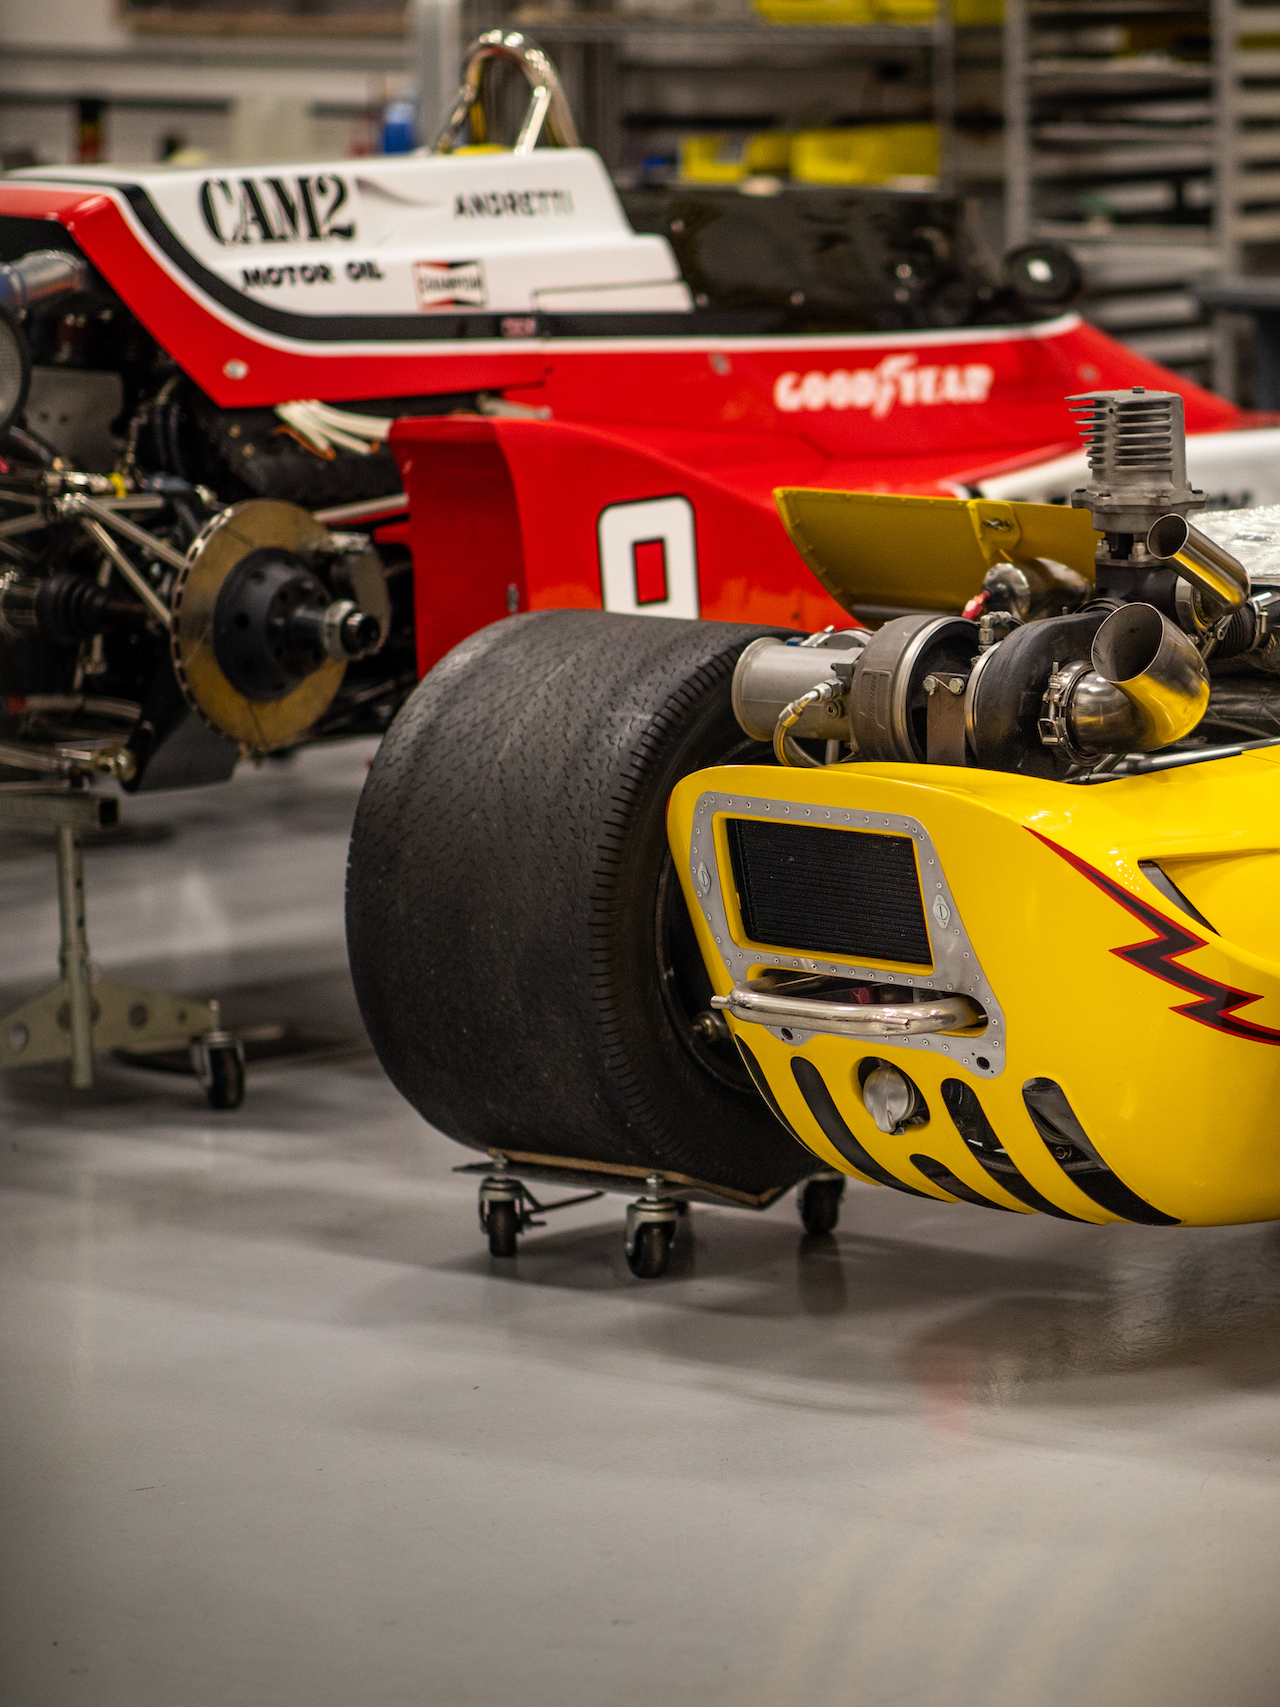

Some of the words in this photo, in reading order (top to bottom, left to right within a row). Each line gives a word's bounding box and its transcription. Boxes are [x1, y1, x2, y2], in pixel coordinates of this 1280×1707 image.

[199, 175, 356, 246] CAM2
[454, 190, 574, 220] ANDRETTI
[241, 264, 335, 291] MOTOR
[346, 262, 384, 281] OIL
[774, 353, 994, 419] GOODYEAR
